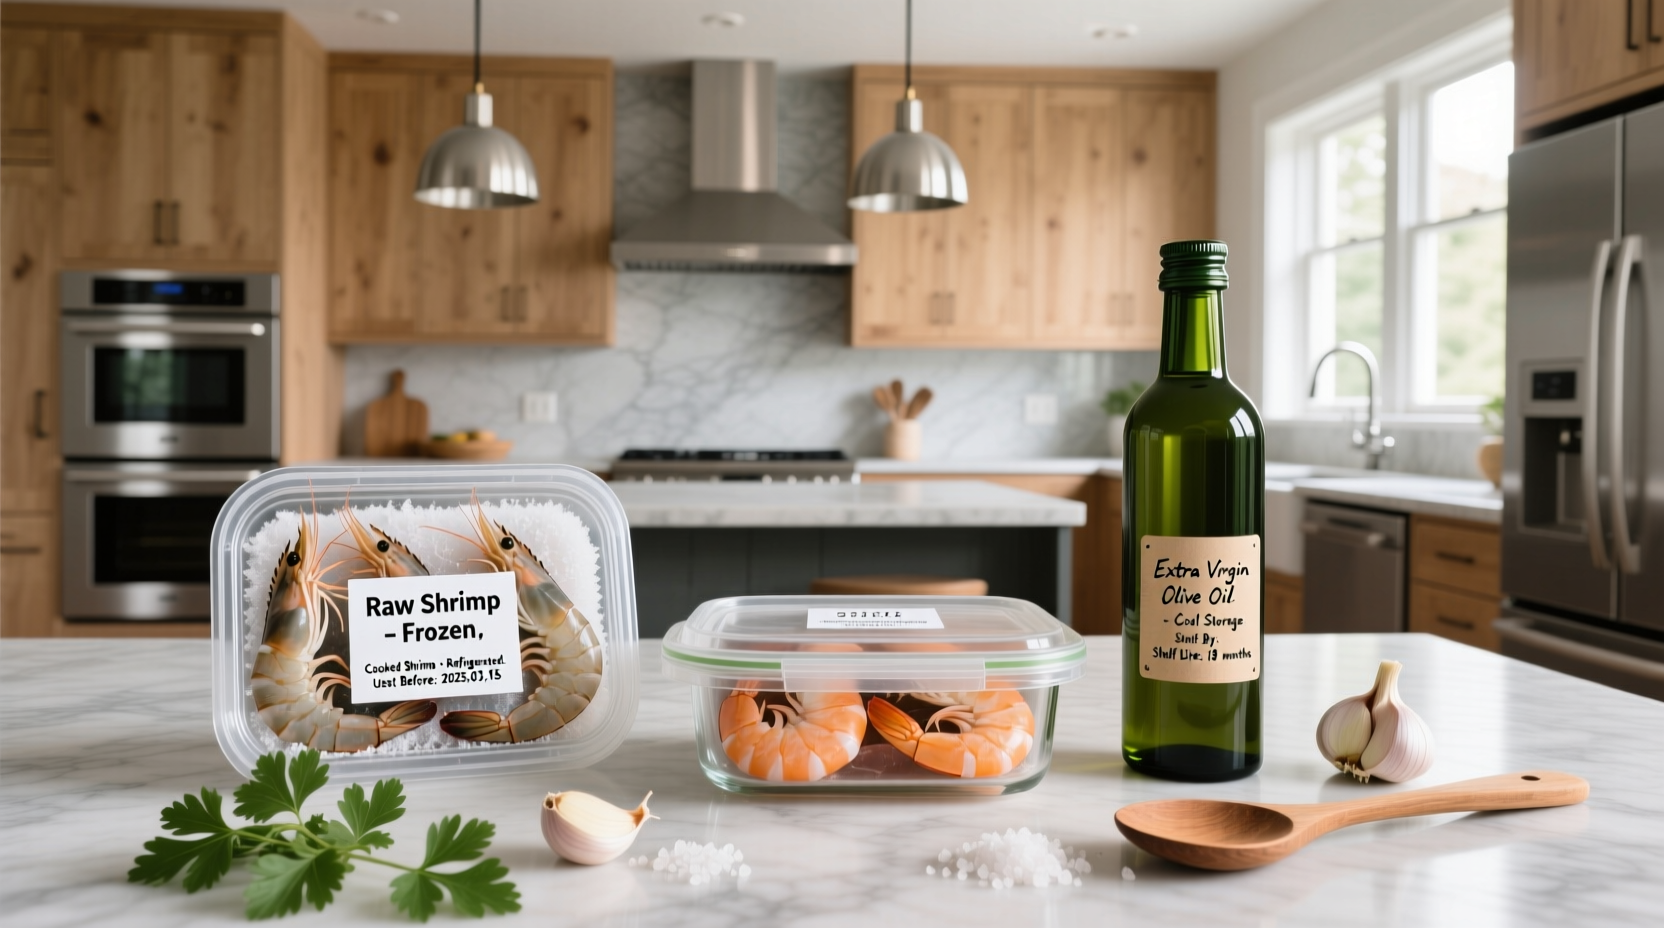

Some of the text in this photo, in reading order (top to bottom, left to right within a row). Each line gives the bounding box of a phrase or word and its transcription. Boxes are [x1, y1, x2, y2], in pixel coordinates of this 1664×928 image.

[1153, 558, 1200, 579] Extra
[366, 590, 501, 617] Raw Shrimp
[1161, 585, 1202, 605] Olive
[402, 621, 484, 643] Frozen,
